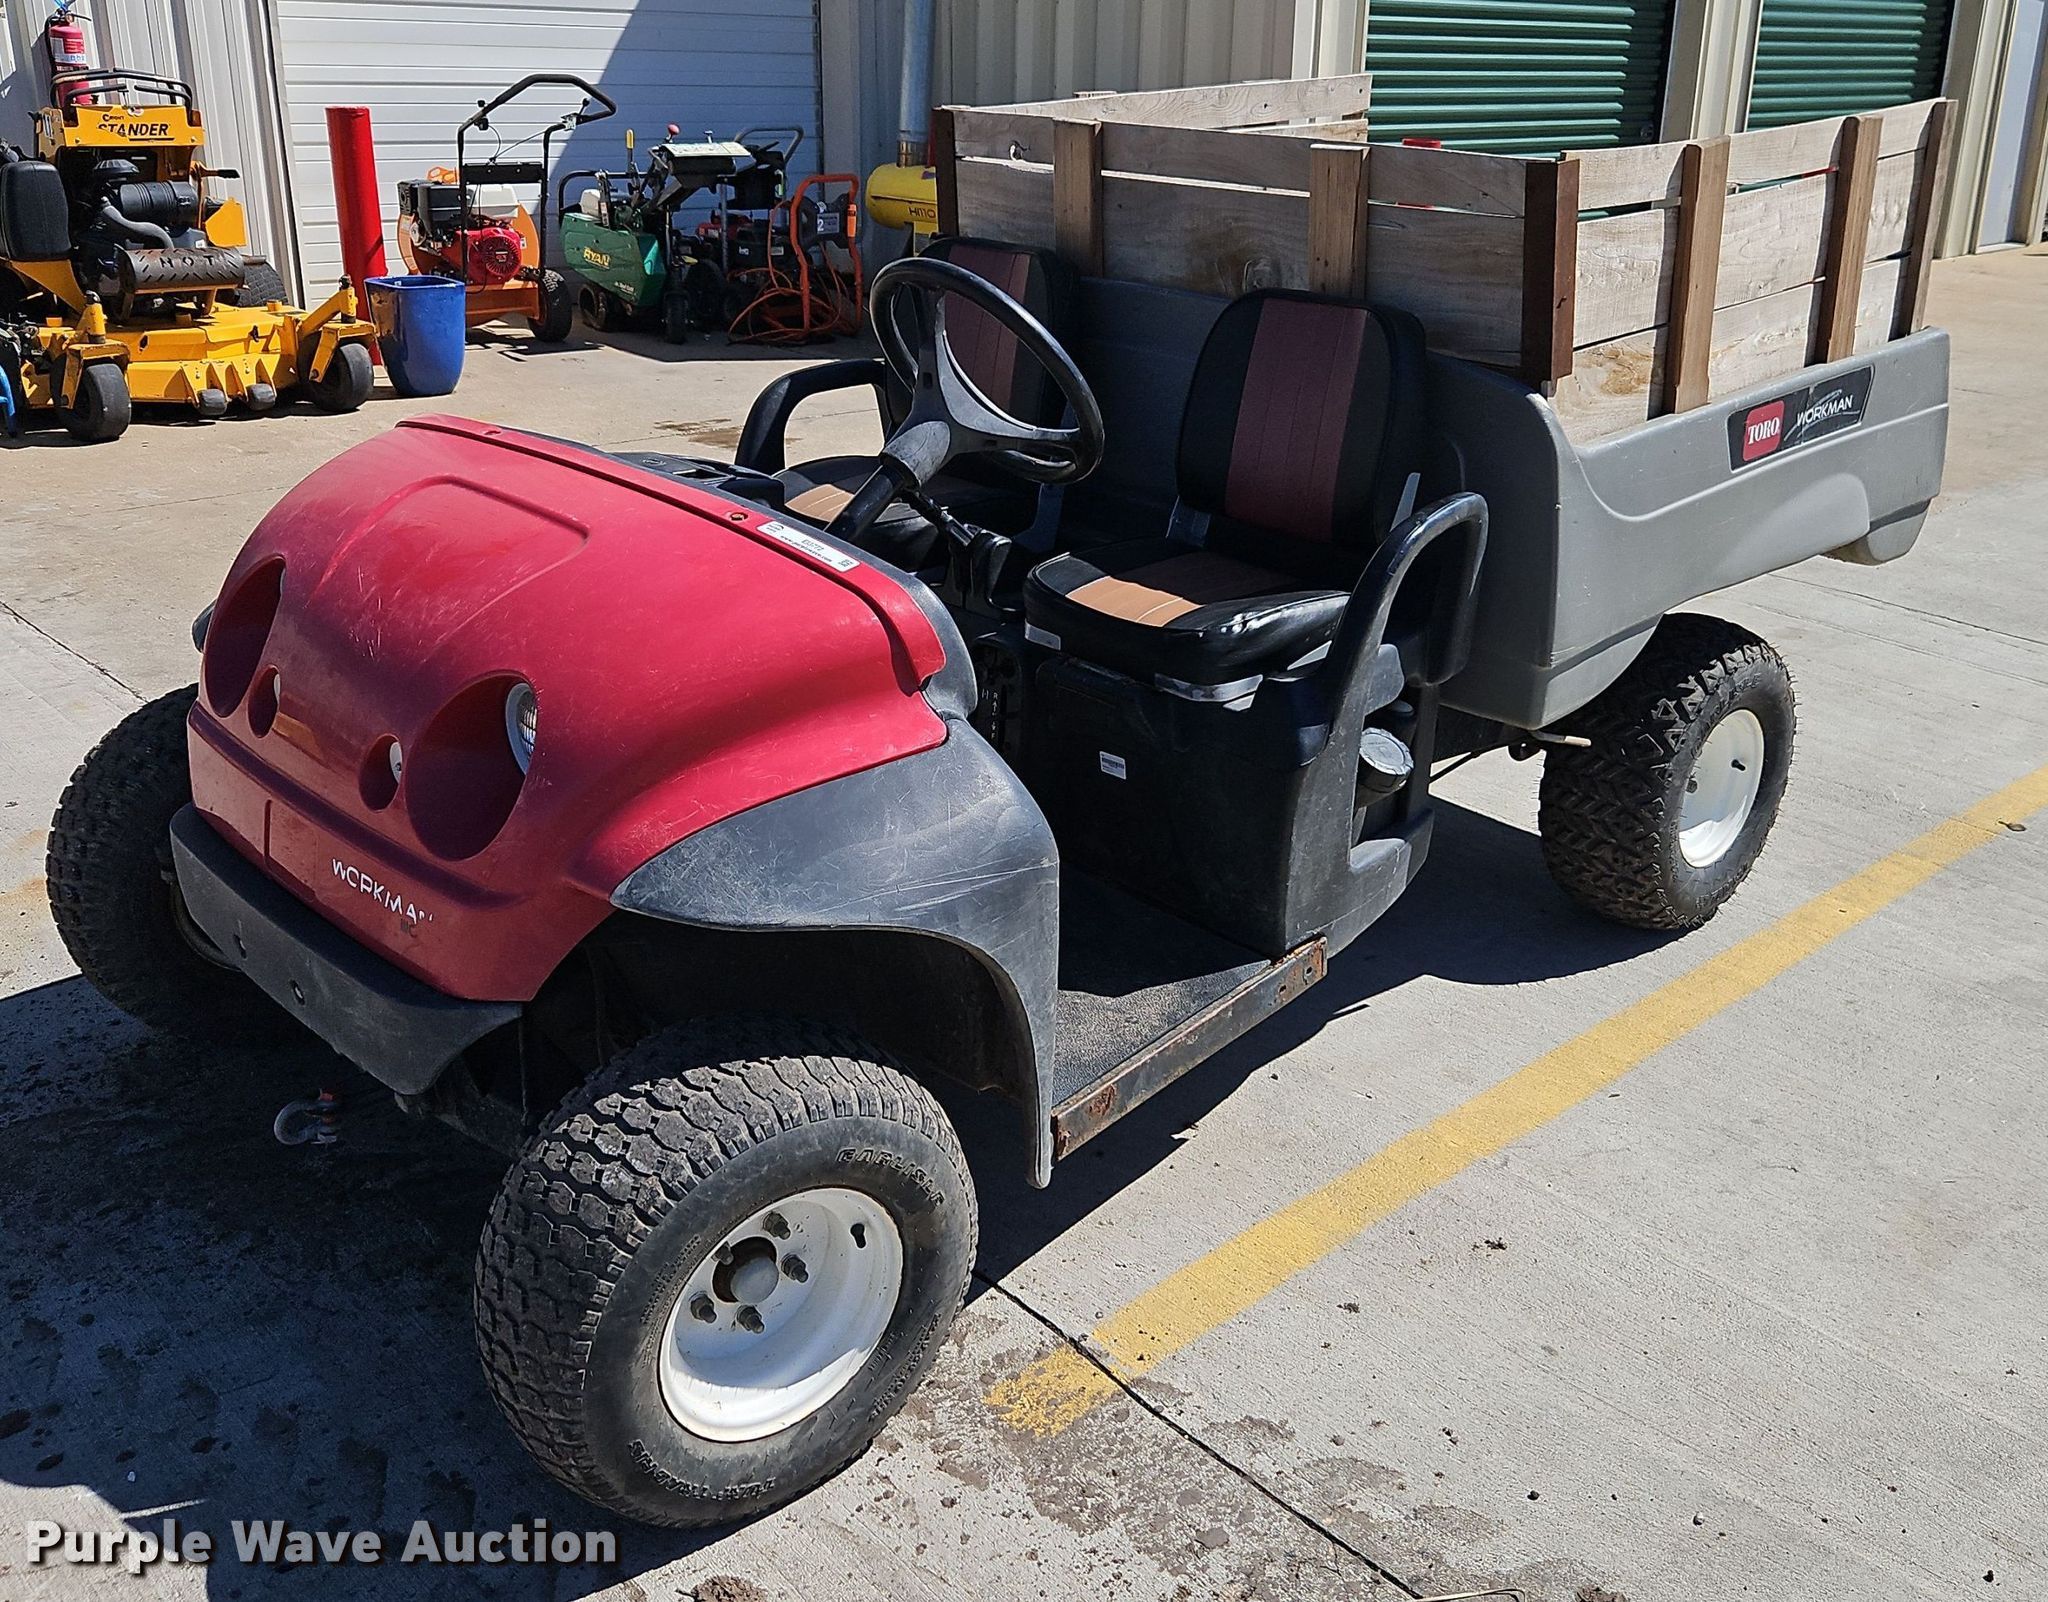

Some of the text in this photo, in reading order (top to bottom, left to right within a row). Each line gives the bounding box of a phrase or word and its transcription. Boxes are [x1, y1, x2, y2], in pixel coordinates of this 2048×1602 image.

[583, 247, 611, 267] RYAN
[1797, 394, 1853, 427] WORKMAN
[1748, 417, 1780, 444] TORO
